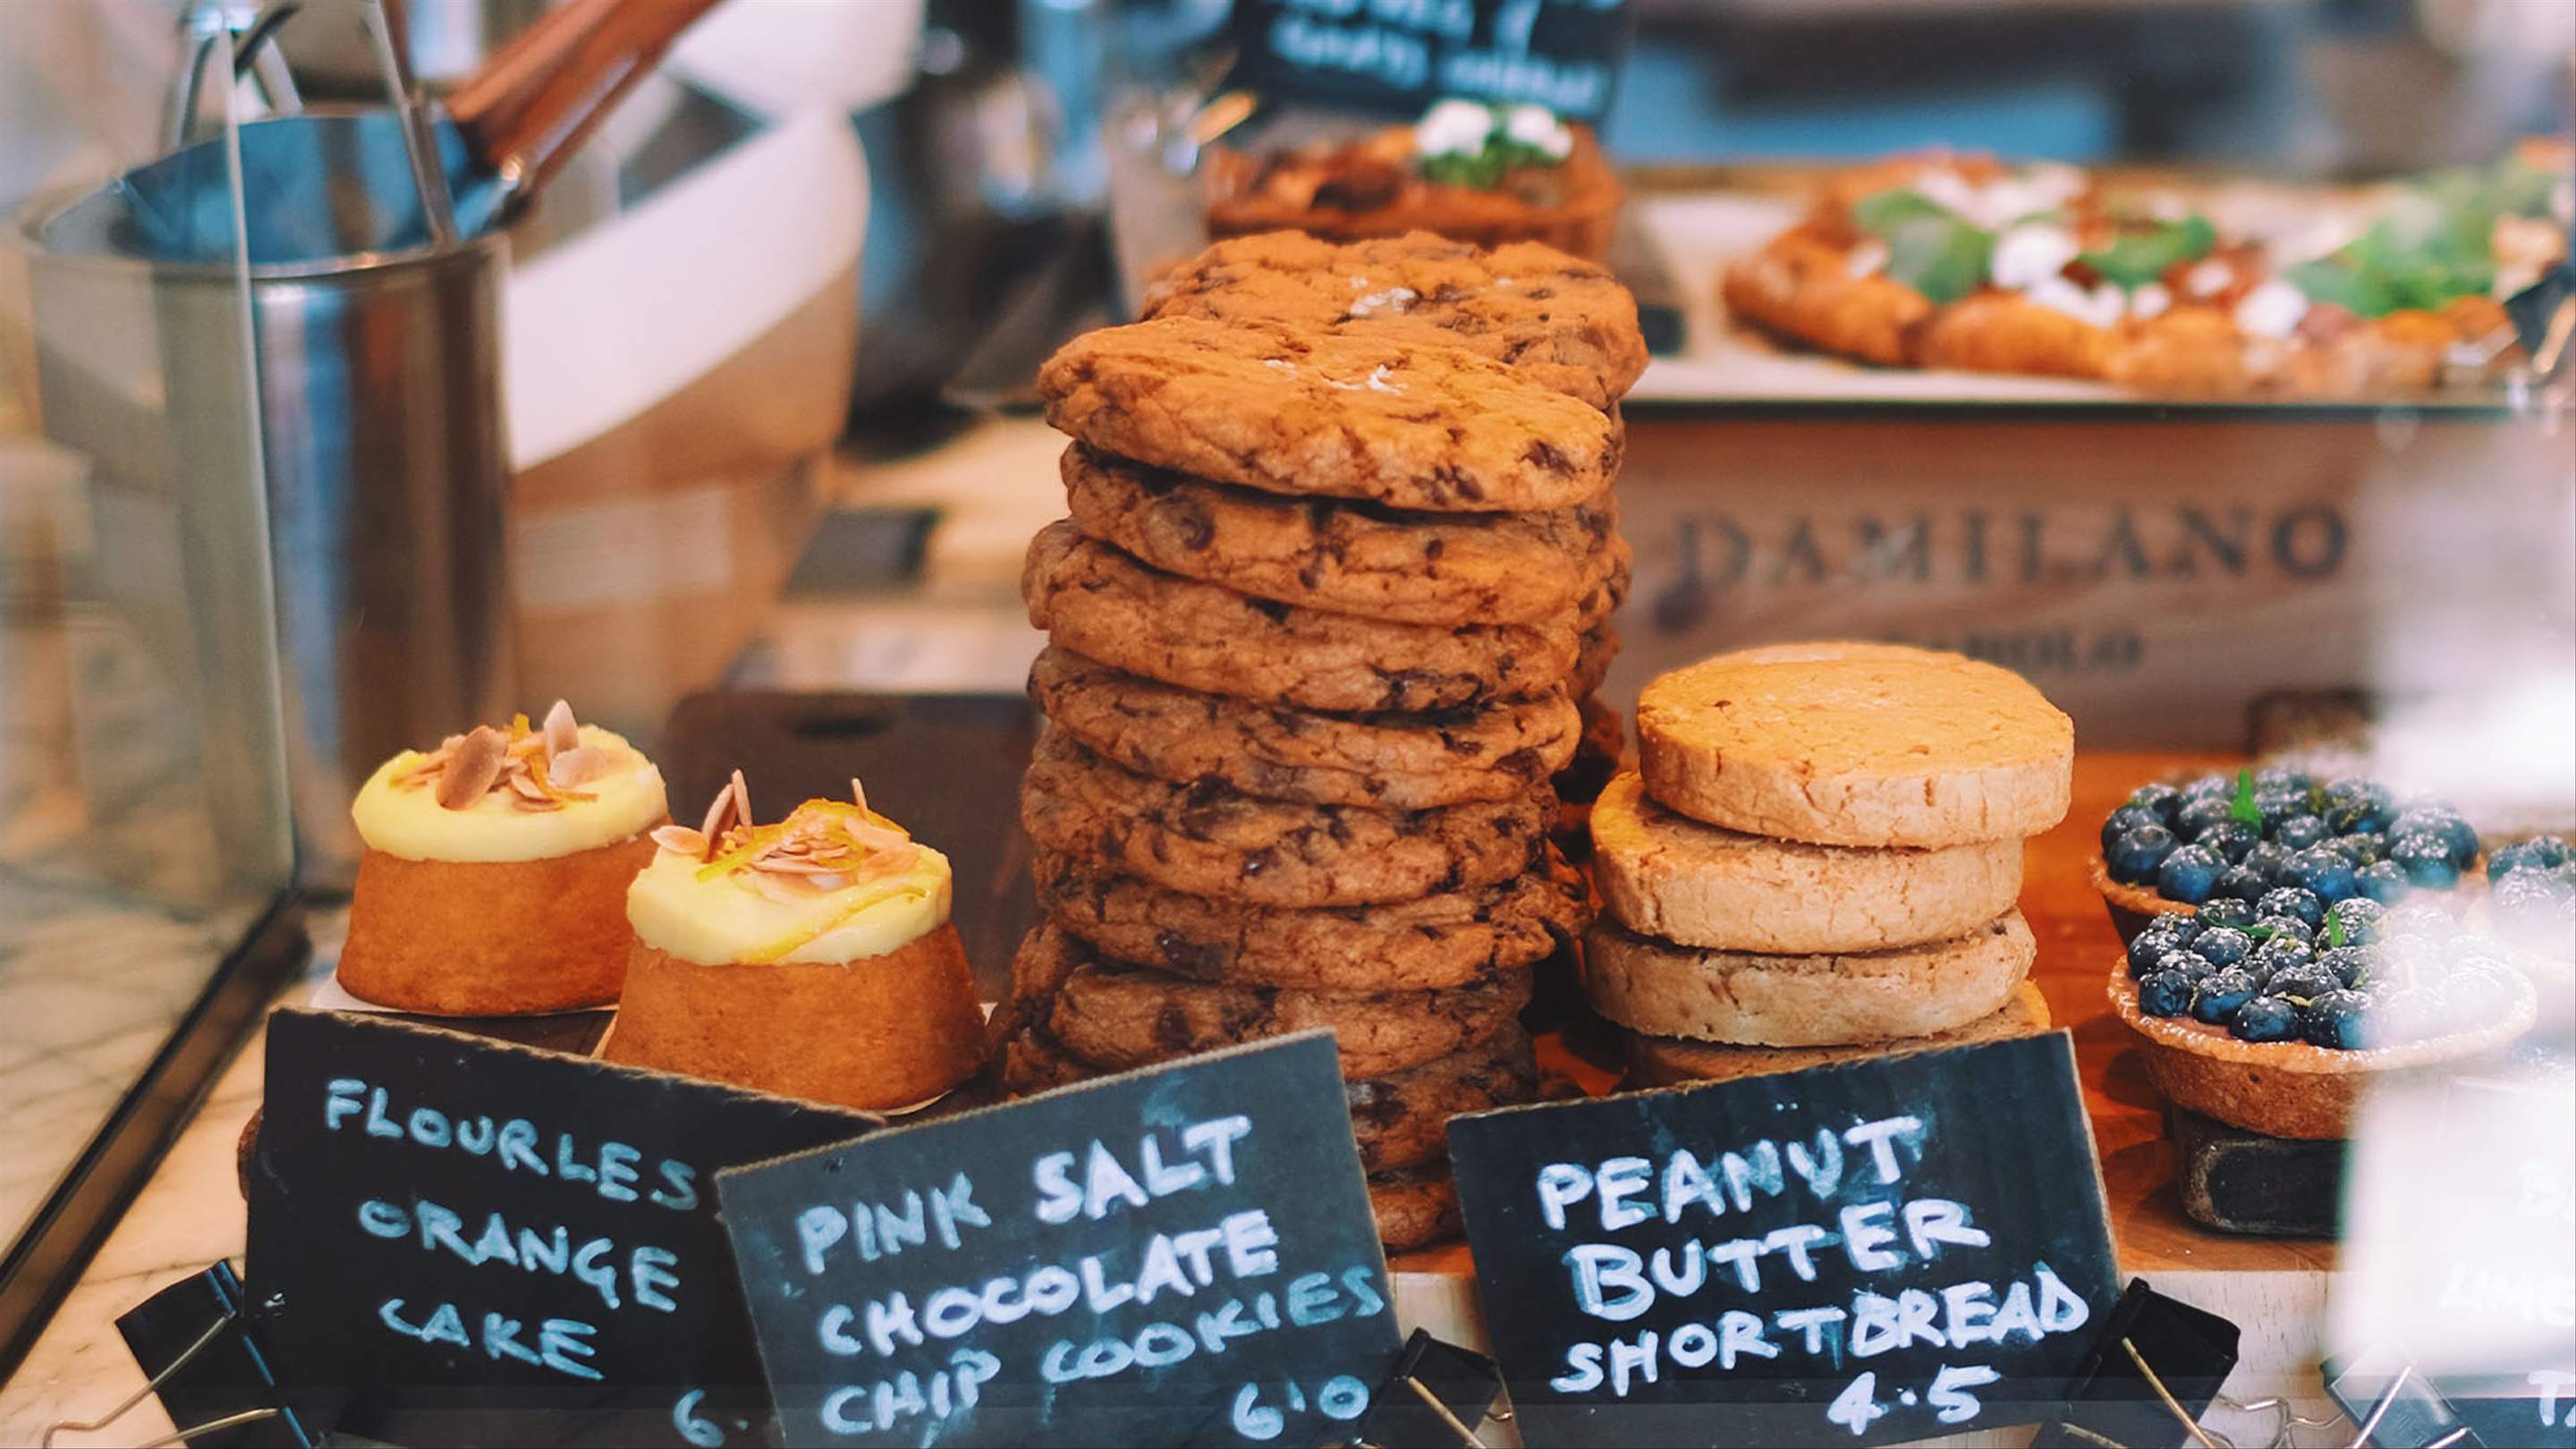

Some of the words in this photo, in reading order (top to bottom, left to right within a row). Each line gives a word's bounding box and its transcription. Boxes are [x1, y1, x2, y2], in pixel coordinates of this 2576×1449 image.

[1673, 504, 2349, 583] DAMILANO
[324, 1078, 699, 1211] FLOURLES
[796, 1172, 992, 1275] PINK
[1033, 1115, 1251, 1224] SALT
[1538, 1114, 1923, 1230] PEANUT
[360, 1200, 680, 1309] ORANGE
[819, 1208, 1280, 1357] CHOCOLATE
[1564, 1199, 1990, 1322] BUTTER
[379, 1299, 605, 1380] CAKE
[822, 1347, 1000, 1434] CHIP
[1041, 1265, 1384, 1384] COOKIES
[1550, 1260, 2089, 1396] SHORTBREAD
